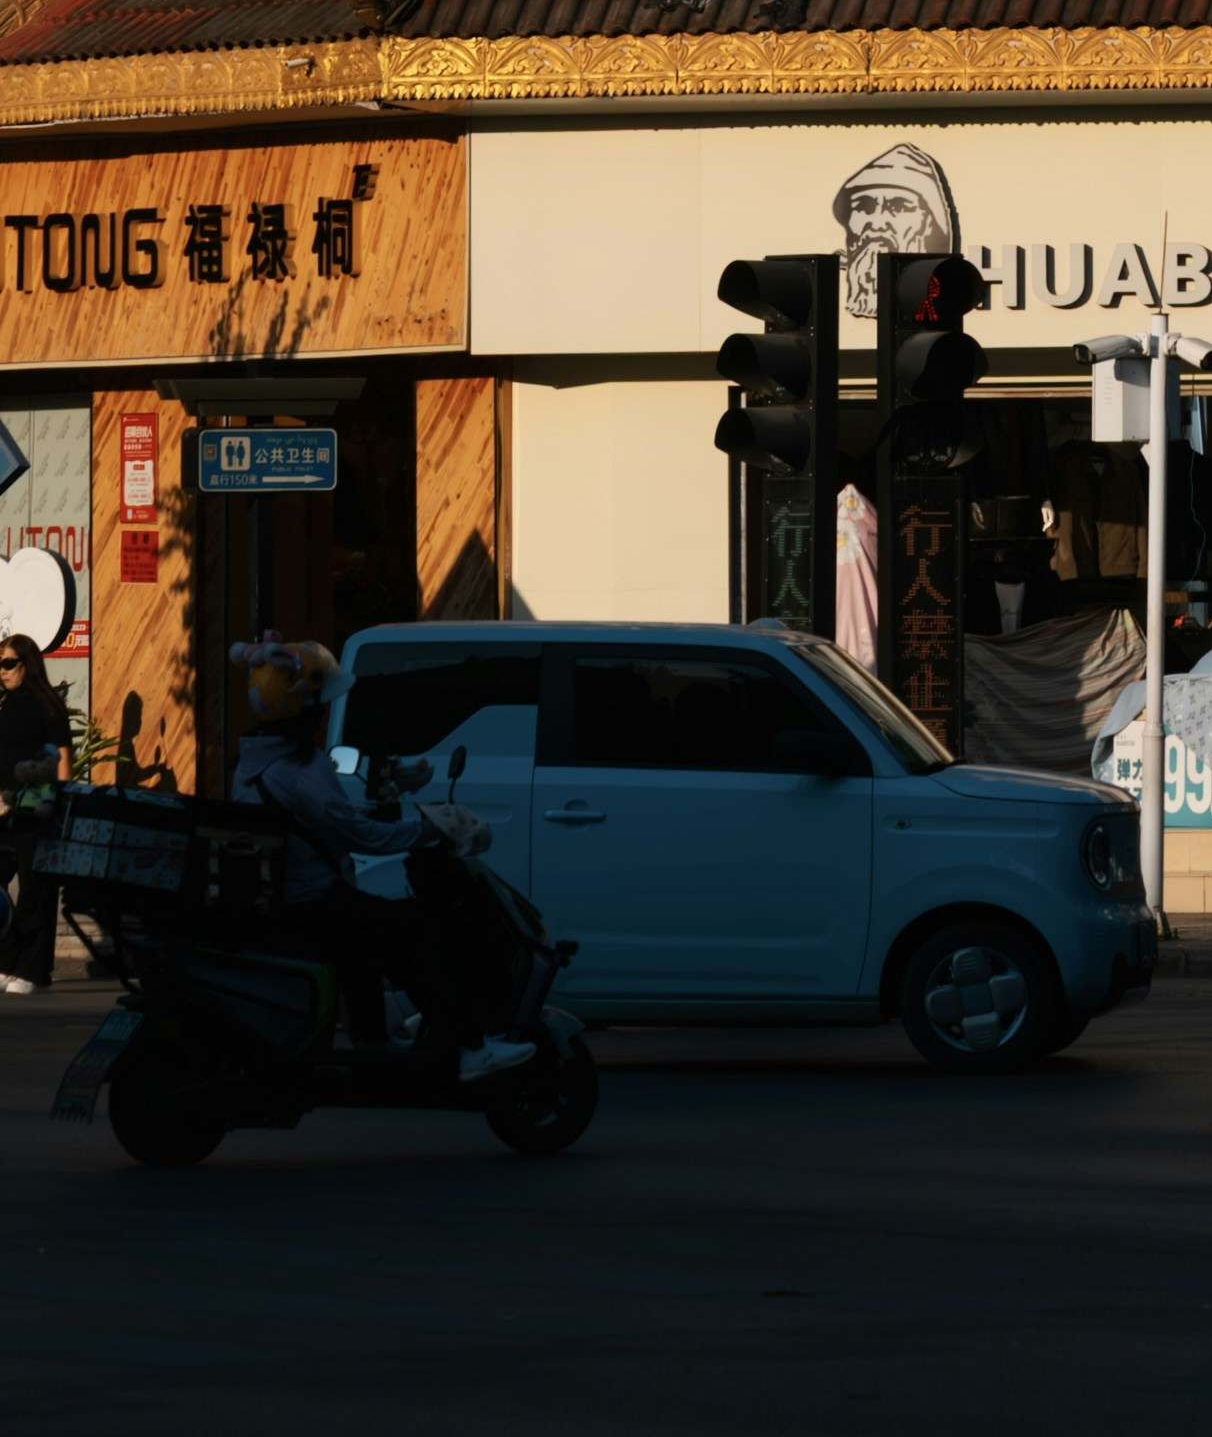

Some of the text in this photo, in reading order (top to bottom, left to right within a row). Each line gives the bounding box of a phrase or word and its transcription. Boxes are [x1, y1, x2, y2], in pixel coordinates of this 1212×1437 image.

[184, 197, 361, 283] 福禄桐
[255, 446, 330, 464] 公共卫生间
[210, 474, 258, 486] 直行150米
